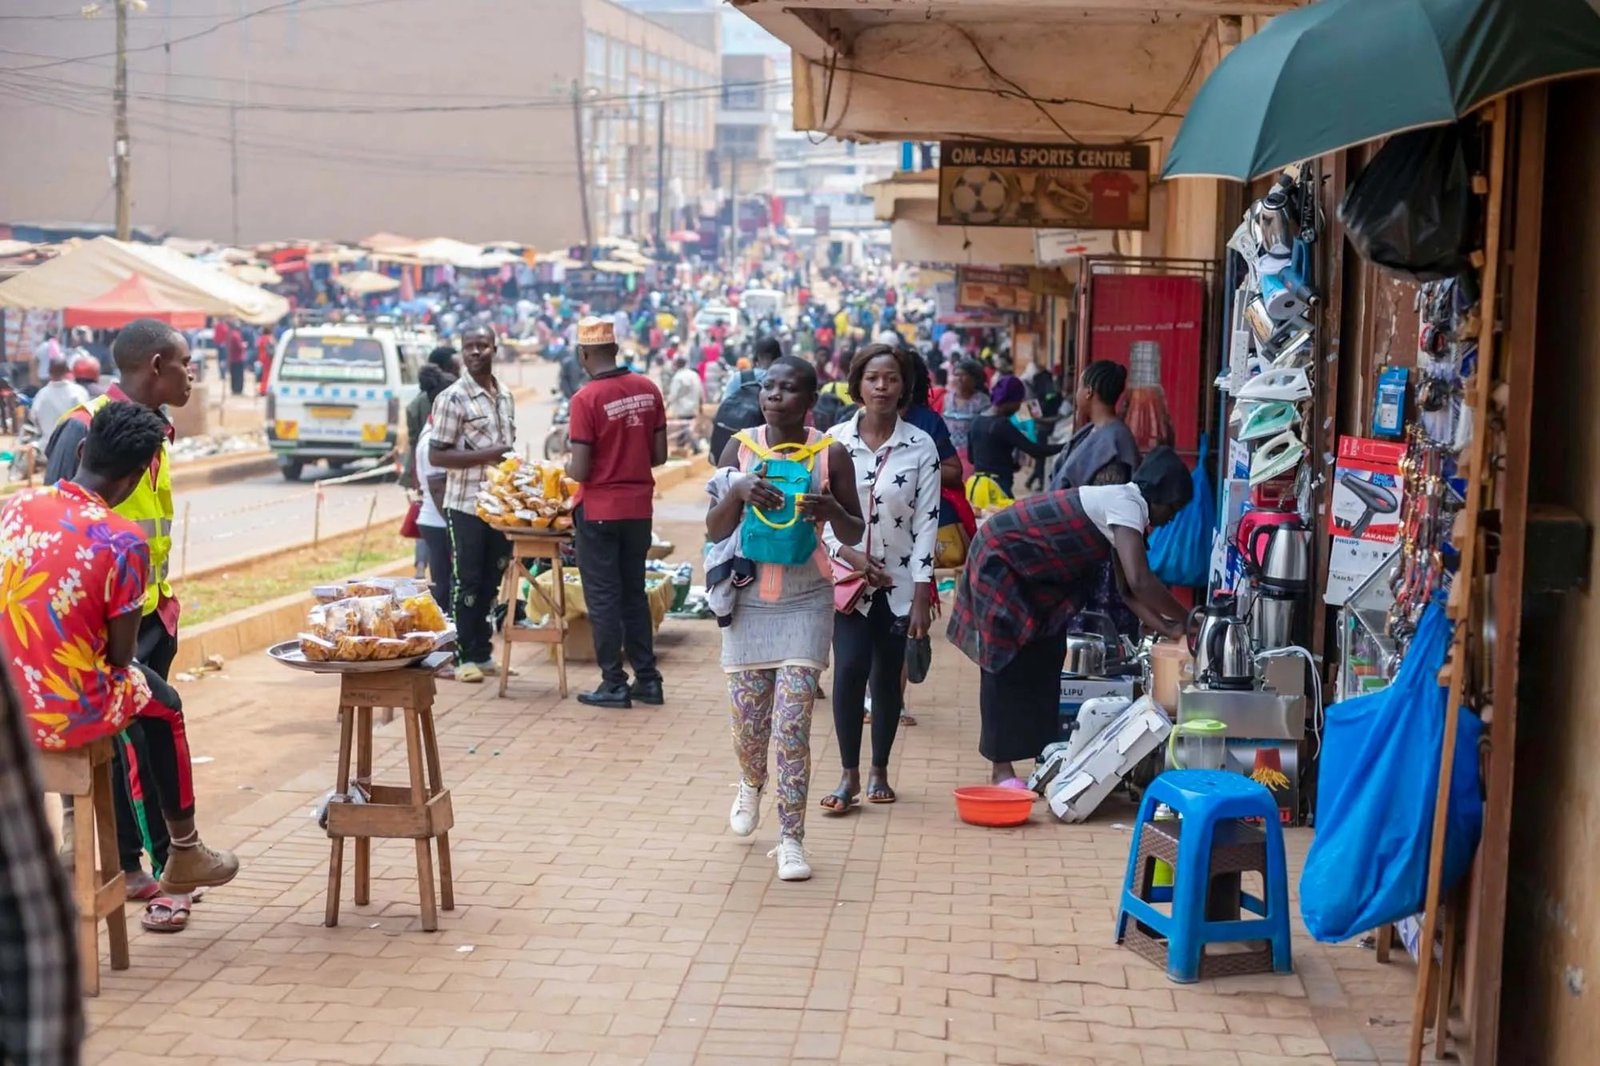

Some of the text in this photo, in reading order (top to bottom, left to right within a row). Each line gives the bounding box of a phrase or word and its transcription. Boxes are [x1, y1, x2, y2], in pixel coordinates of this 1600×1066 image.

[951, 148, 1132, 168] OM-ASIA SPORTS CENTRE
